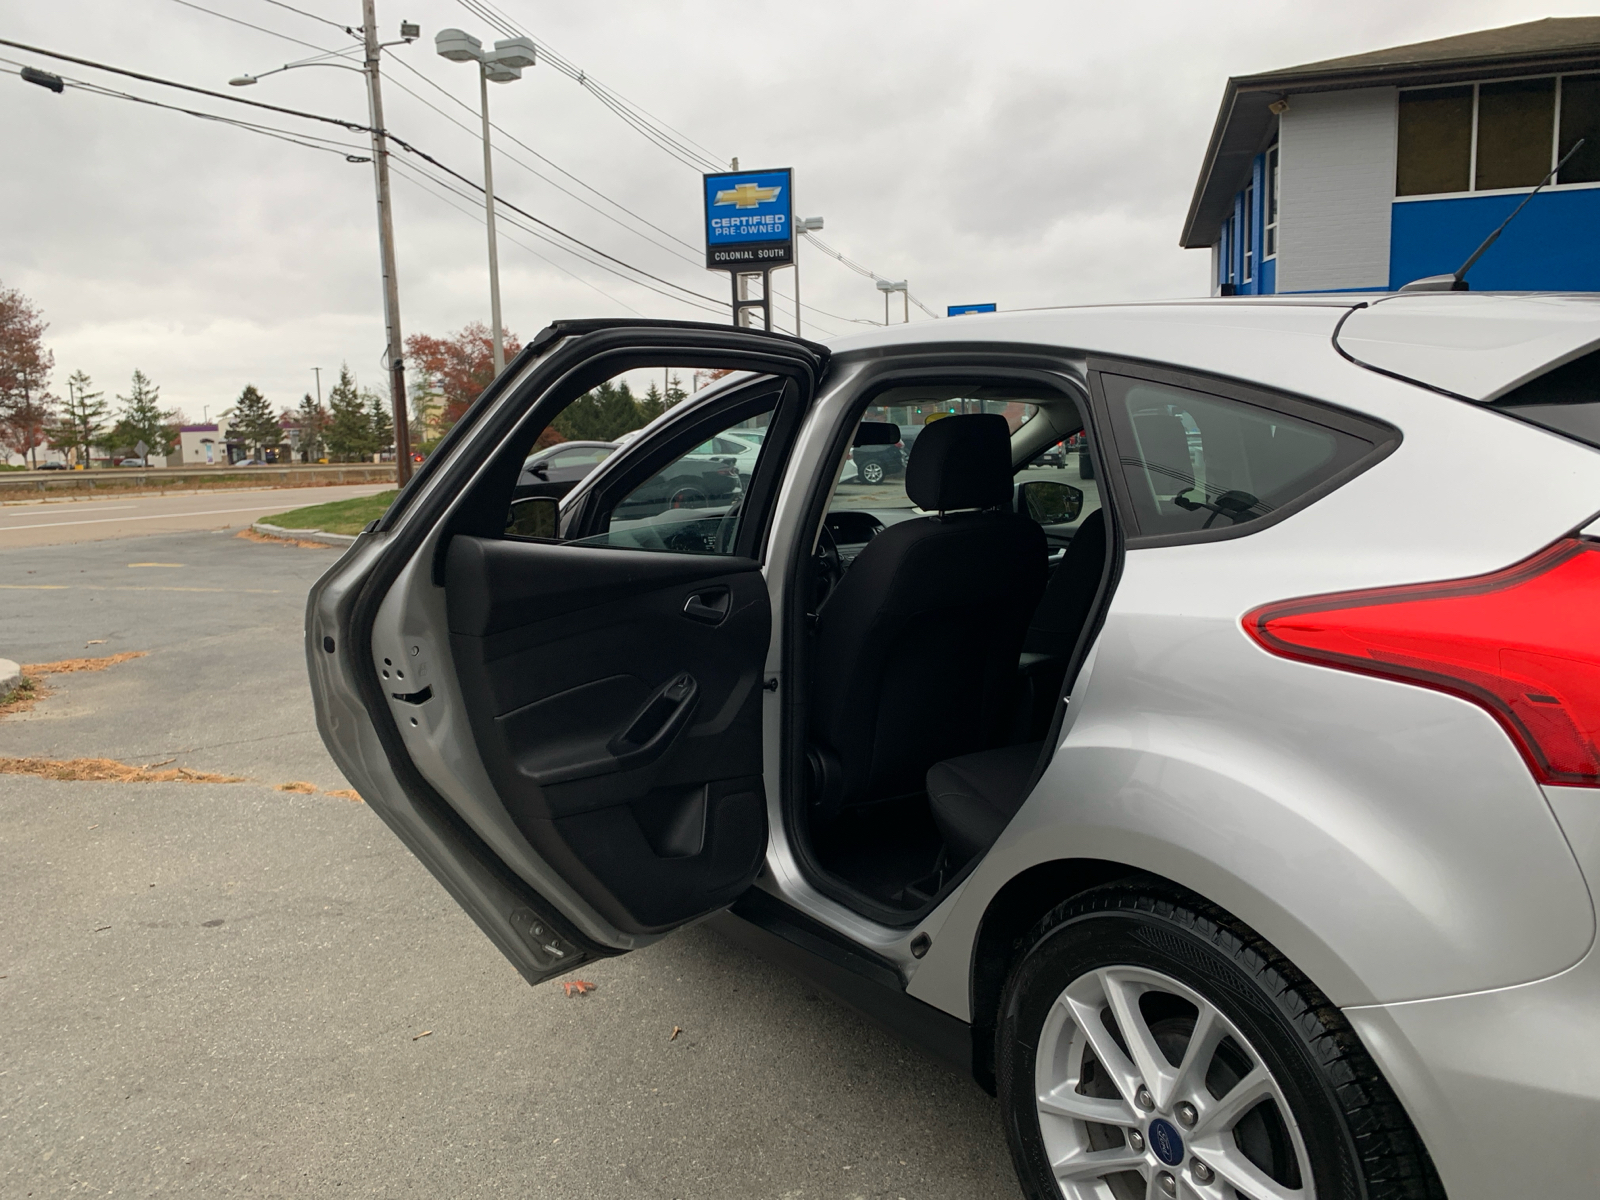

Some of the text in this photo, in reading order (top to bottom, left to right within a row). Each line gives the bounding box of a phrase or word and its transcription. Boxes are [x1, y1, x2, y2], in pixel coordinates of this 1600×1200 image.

[711, 214, 785, 227] CERTIFIED
[715, 224, 782, 236] PRE-OWNED
[714, 249, 784, 260] COLONIAL SOUTH
[1158, 1130, 1170, 1156] Ford
